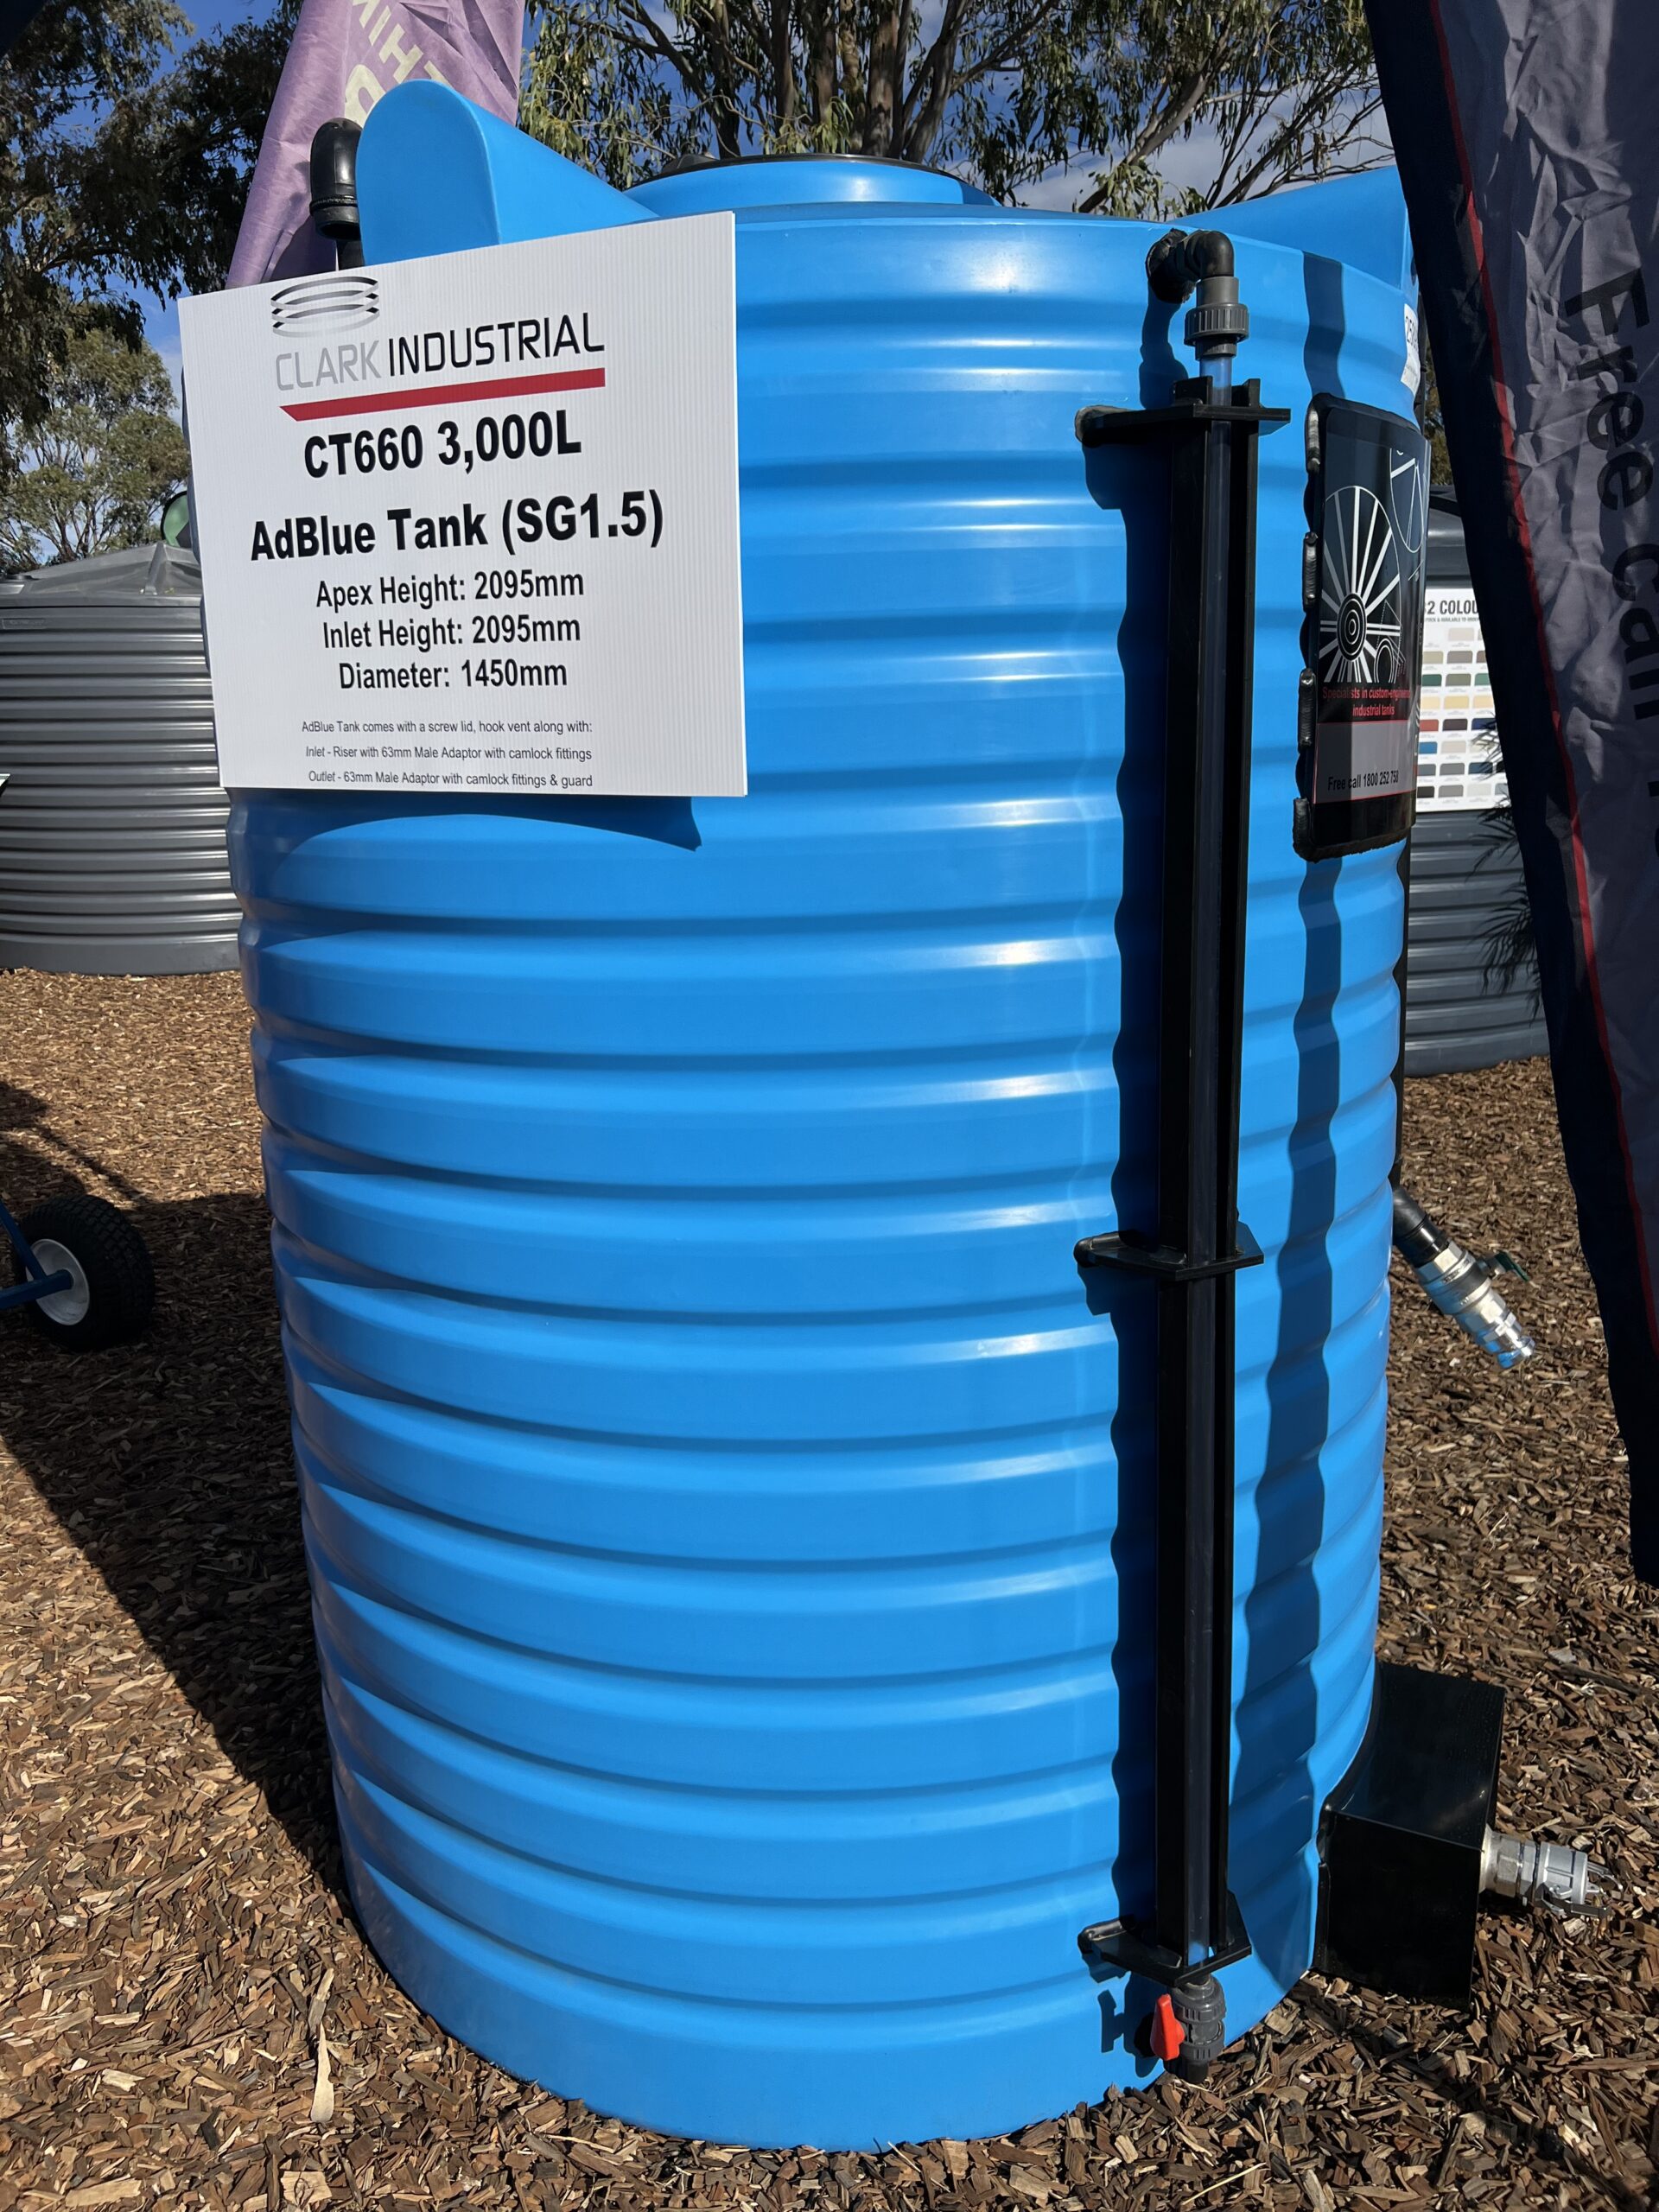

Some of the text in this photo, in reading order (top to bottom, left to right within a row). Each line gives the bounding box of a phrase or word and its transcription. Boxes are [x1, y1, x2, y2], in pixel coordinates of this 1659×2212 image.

[276, 313, 604, 391] CLARK INDUSTRIAL
[1565, 267, 1654, 512] Free
[305, 410, 582, 478] CT660 3,000L
[251, 489, 663, 561] AdBlue Tank (SG1.5)
[316, 569, 583, 613] Apex Height: 2095mm
[1424, 601, 1435, 614] 2
[323, 614, 580, 652] Inlet Height: 2095mm
[340, 658, 567, 689] Diameter: 1450mm
[1323, 686, 1359, 699] Specialists
[1362, 687, 1368, 699] in
[1352, 703, 1395, 716] industrial tanks
[302, 720, 592, 735] AdBlue Tank comes with a screw lid, hook vent along with:
[306, 747, 325, 757] Inlet
[333, 747, 358, 757] Riser
[359, 747, 378, 758] with
[381, 747, 411, 758] 63mm
[414, 747, 438, 758] Male
[442, 747, 481, 761] Adaptor
[484, 747, 505, 759] with
[509, 747, 553, 759] camlock
[556, 747, 592, 762] fittings
[308, 771, 335, 781] Outlet
[344, 772, 372, 782] 63mm
[375, 772, 398, 782] Male
[403, 772, 440, 785] Adaptor
[442, 772, 462, 784] with
[467, 773, 509, 785] camlock
[512, 773, 546, 788] fittings
[550, 774, 557, 785] &
[562, 775, 593, 788] guard
[1328, 776, 1345, 791] Free
[1348, 773, 1362, 788] call
[1363, 772, 1378, 787] 1800
[1379, 771, 1390, 785] 252
